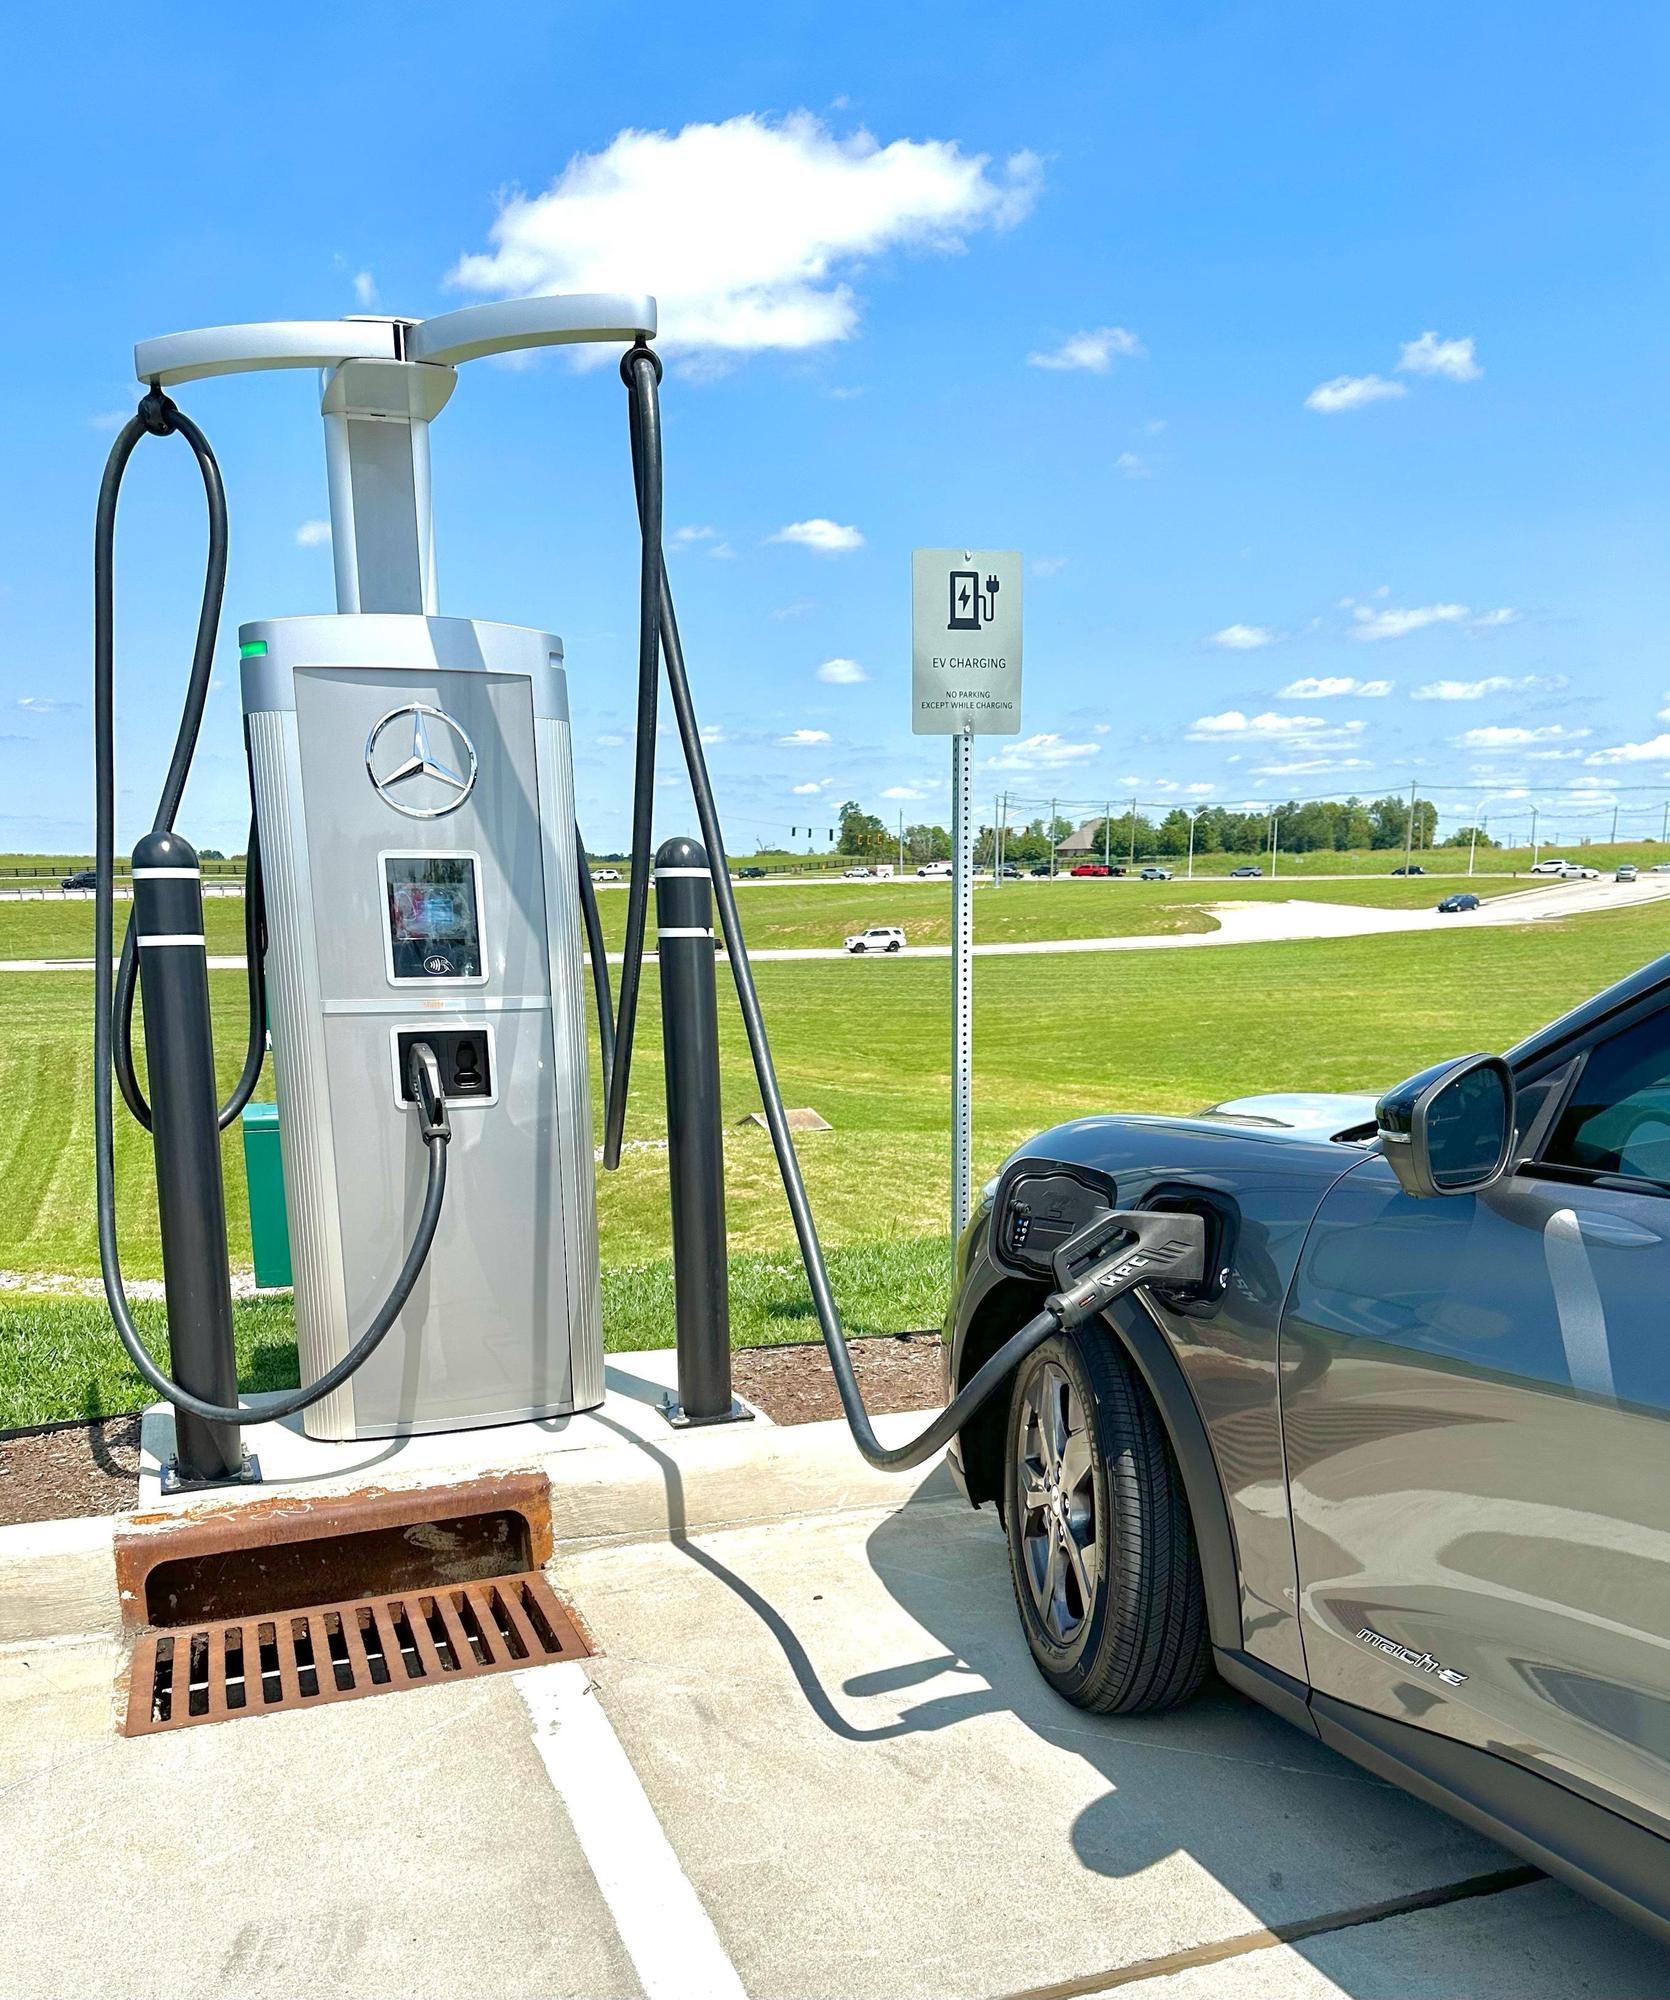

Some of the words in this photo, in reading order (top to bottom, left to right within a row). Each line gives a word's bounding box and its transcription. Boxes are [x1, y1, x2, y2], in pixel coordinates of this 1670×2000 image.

[932, 657, 947, 668] EV
[949, 657, 1006, 669] CHARGING
[946, 690, 958, 699] NO
[959, 690, 991, 699] PARKING
[921, 701, 949, 710] EXCEPT
[951, 701, 974, 709] WHILE
[976, 701, 1013, 710] CHARGING
[1099, 1255, 1150, 1287] HPC
